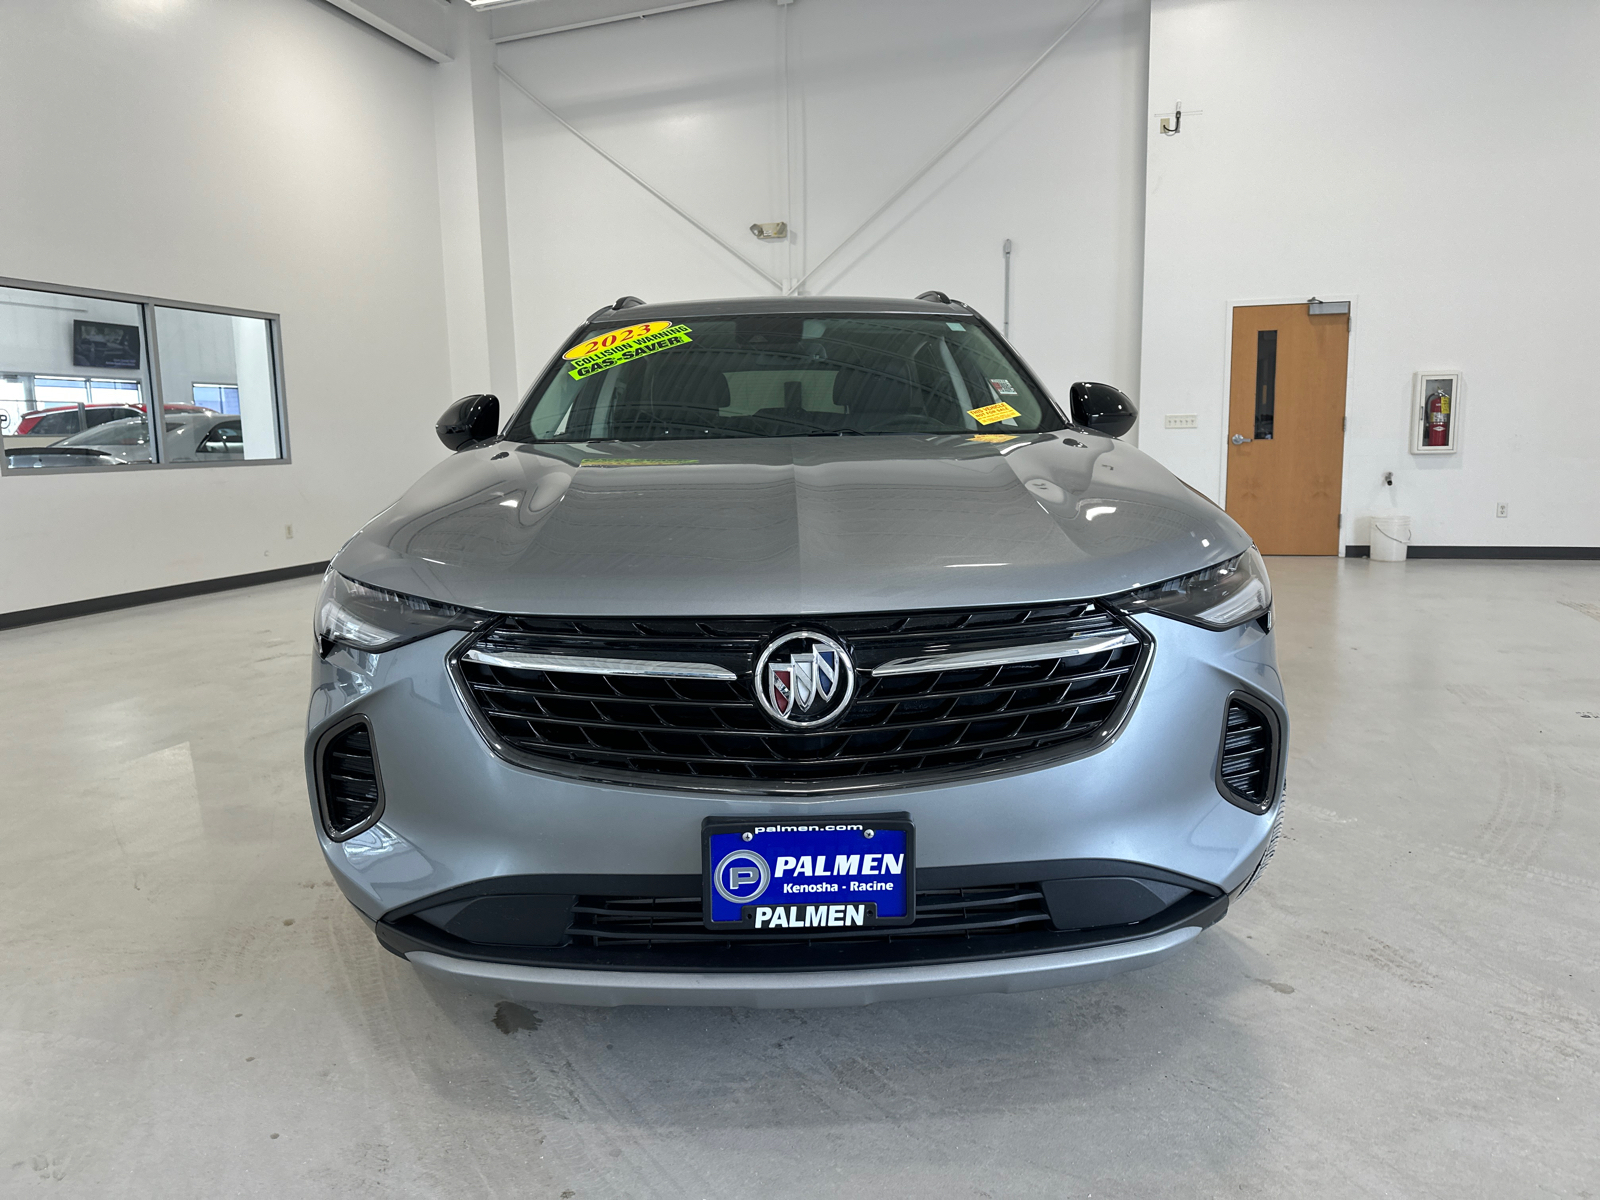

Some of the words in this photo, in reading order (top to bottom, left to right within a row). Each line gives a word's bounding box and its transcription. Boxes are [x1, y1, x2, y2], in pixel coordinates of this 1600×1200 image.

[575, 342, 633, 367] COLLISION
[632, 326, 689, 346] WARNING
[584, 324, 652, 356] 2023
[577, 335, 682, 377] GAS-SAVER
[754, 824, 863, 834] palmen.com
[774, 853, 905, 878] PALMEN
[783, 883, 838, 893] Kenosha
[850, 881, 894, 892] Racine
[754, 904, 865, 929] PALMEN
